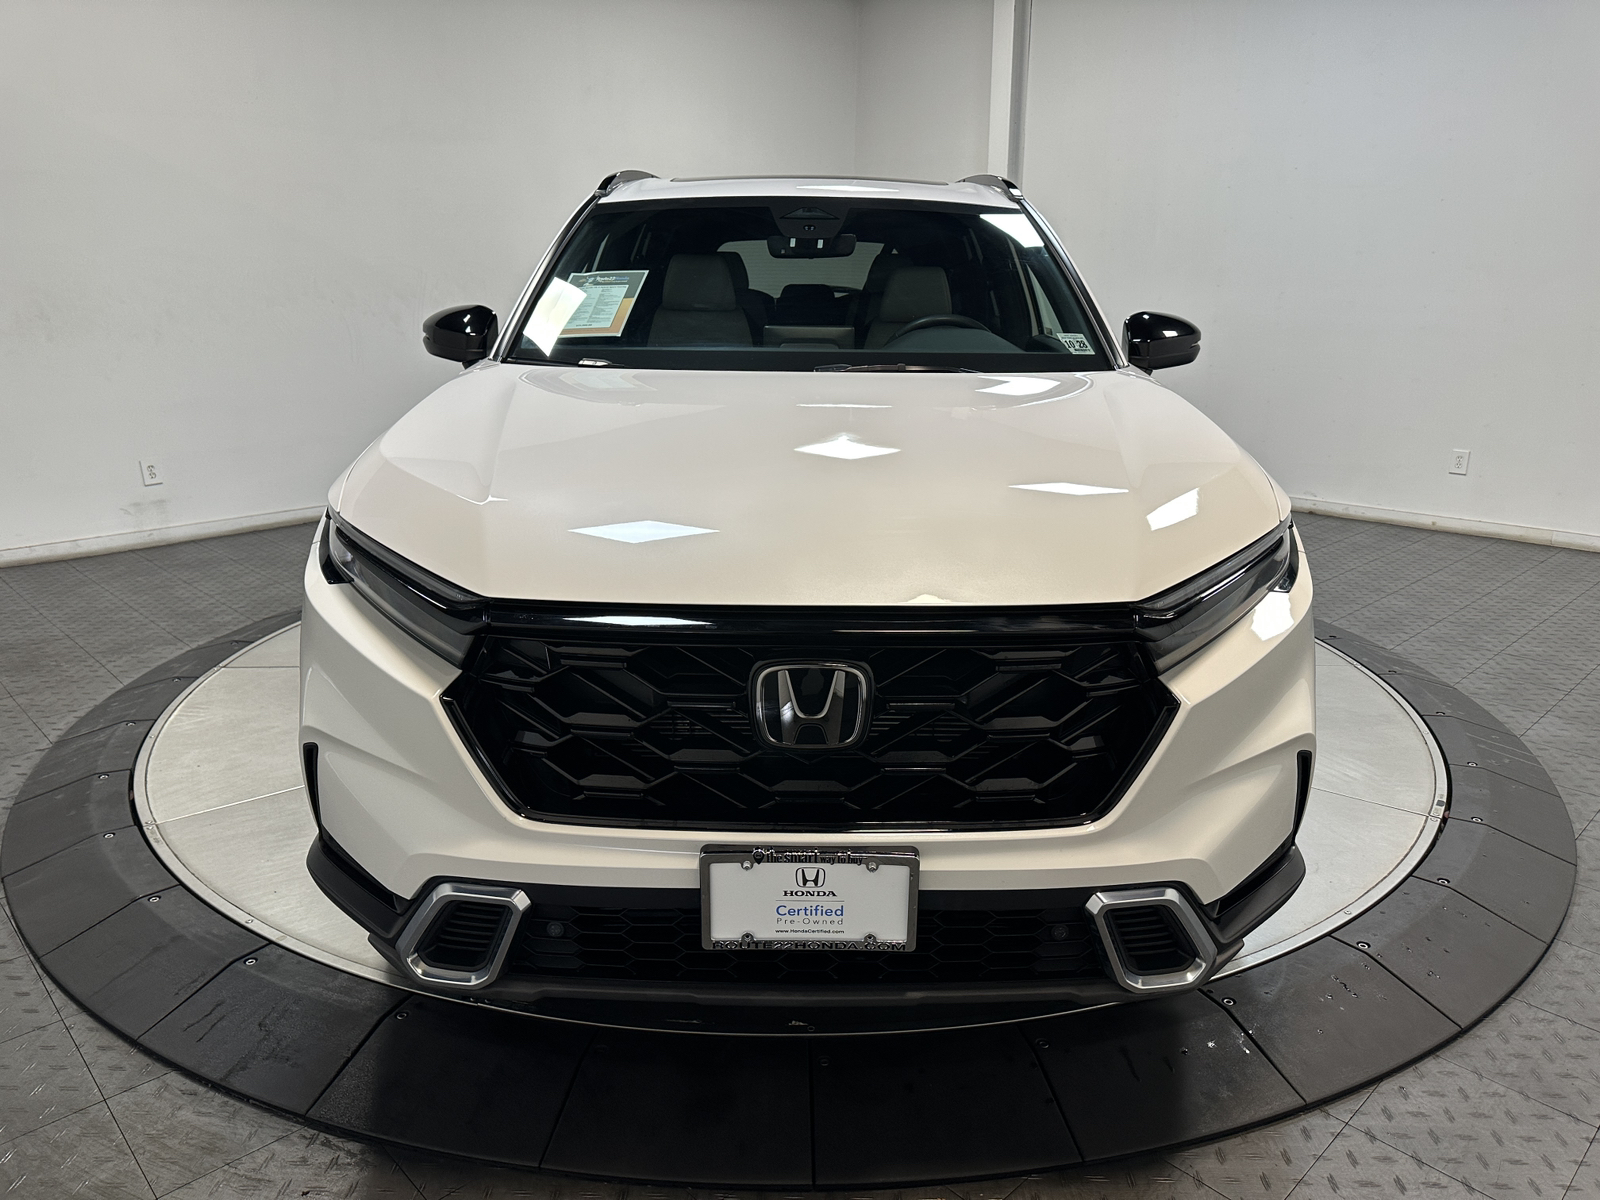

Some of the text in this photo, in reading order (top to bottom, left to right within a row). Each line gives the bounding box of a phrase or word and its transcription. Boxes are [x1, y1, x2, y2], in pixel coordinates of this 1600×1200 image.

[1064, 340, 1088, 348] 10 28
[766, 850, 863, 866] the smart way to buy
[776, 905, 844, 917] Certified
[712, 941, 906, 951] ROUTE22HONDA.COM
